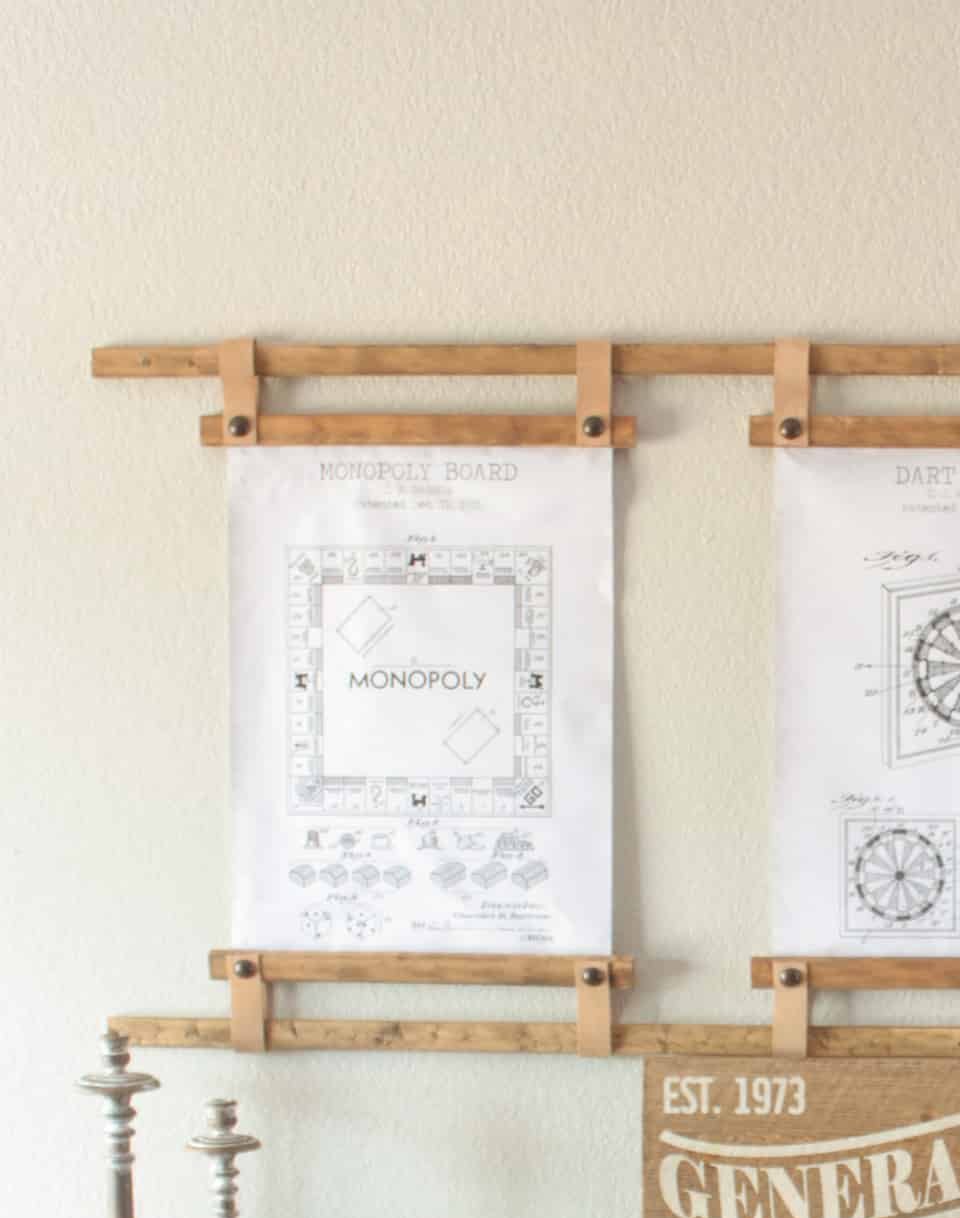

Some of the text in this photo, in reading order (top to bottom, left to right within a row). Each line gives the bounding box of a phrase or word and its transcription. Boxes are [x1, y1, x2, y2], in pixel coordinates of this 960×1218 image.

[320, 462, 519, 481] MONOPOLY BOARD
[896, 465, 956, 485] DART
[350, 670, 488, 690] MONOPOLY
[663, 1076, 806, 1115] EST. 1973
